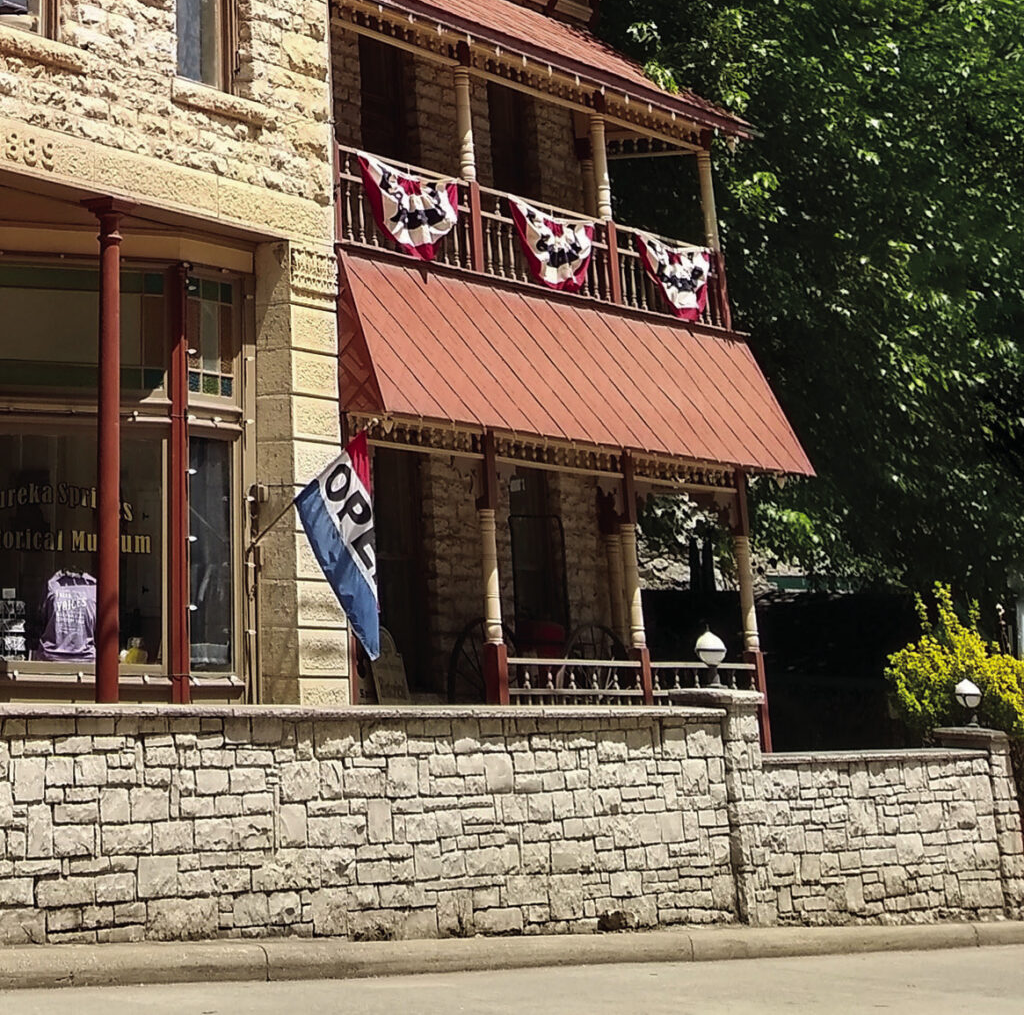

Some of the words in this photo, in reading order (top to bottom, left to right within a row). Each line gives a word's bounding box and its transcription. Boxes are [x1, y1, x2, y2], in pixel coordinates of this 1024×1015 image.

[58, 482, 133, 522] Spris
[72, 530, 151, 554] Muum
[326, 463, 376, 587] OPE
